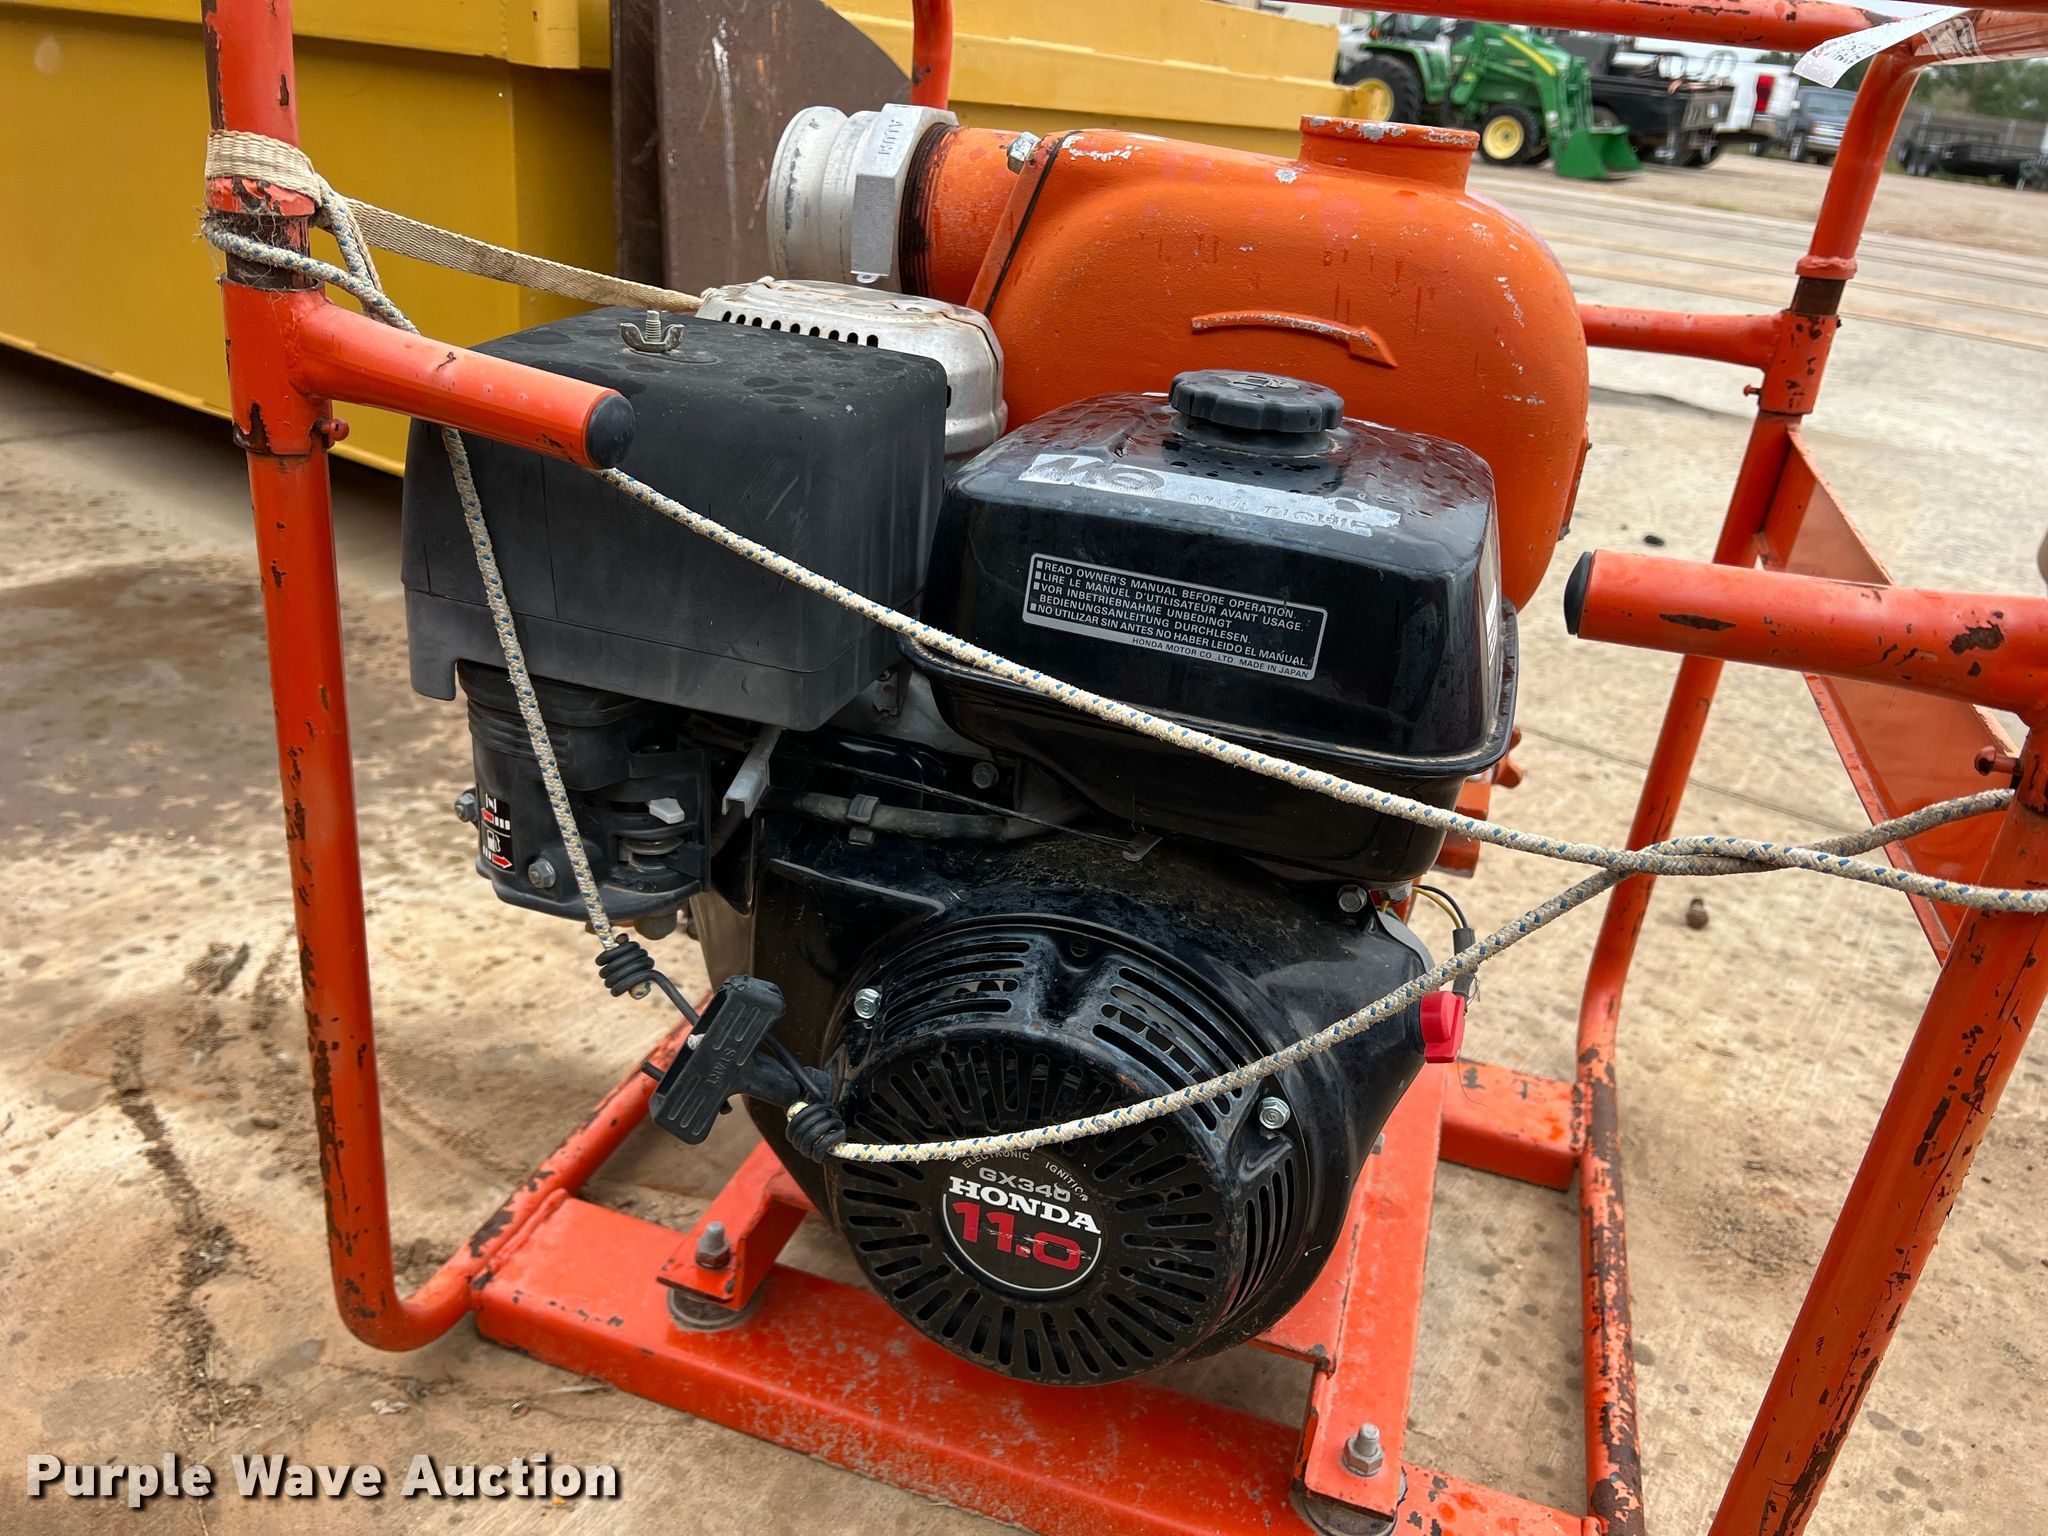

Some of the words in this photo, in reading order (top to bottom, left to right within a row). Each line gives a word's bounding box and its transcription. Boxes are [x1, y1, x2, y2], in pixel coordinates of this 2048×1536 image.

[1041, 583, 1063, 595] VOR
[1067, 588, 1163, 616] INBETRIEBNAHME
[1167, 608, 1233, 629] UNBEDINGT
[1042, 573, 1065, 585] LIRE
[1069, 578, 1081, 588] LE
[1085, 581, 1131, 599] MANUEL
[1135, 591, 1216, 615] D'UTILISATEUR
[1220, 608, 1258, 623] AVANT
[1262, 616, 1304, 632] USAGE.
[1044, 562, 1073, 575] READ
[1076, 568, 1127, 587] OWNER'S
[1130, 579, 1178, 597] MANUAL
[1181, 589, 1225, 606] BEFORE
[1229, 598, 1297, 620] OPERATION.
[1037, 604, 1053, 615] NO
[1054, 607, 1099, 625] UTILIZAR
[1100, 618, 1119, 629] SIN
[1120, 621, 1154, 636] ANTES
[1156, 628, 1172, 639] NO
[1173, 632, 1209, 647] HABER
[1211, 640, 1243, 654] LEIDO
[1244, 646, 1257, 657] EL
[1039, 594, 1170, 628] BEDIENUNGSANLEITUNG
[1174, 621, 1251, 644] DURCHLESEN.
[1132, 637, 1163, 649] HONDA
[1165, 643, 1197, 656] MOTOR
[1239, 658, 1265, 670] MADE
[1267, 664, 1277, 672] IN
[1278, 667, 1309, 678] JAPAN
[949, 1176, 1101, 1235] HONDA
[979, 1167, 1071, 1203] GX340
[952, 1202, 1082, 1271] 11.0
